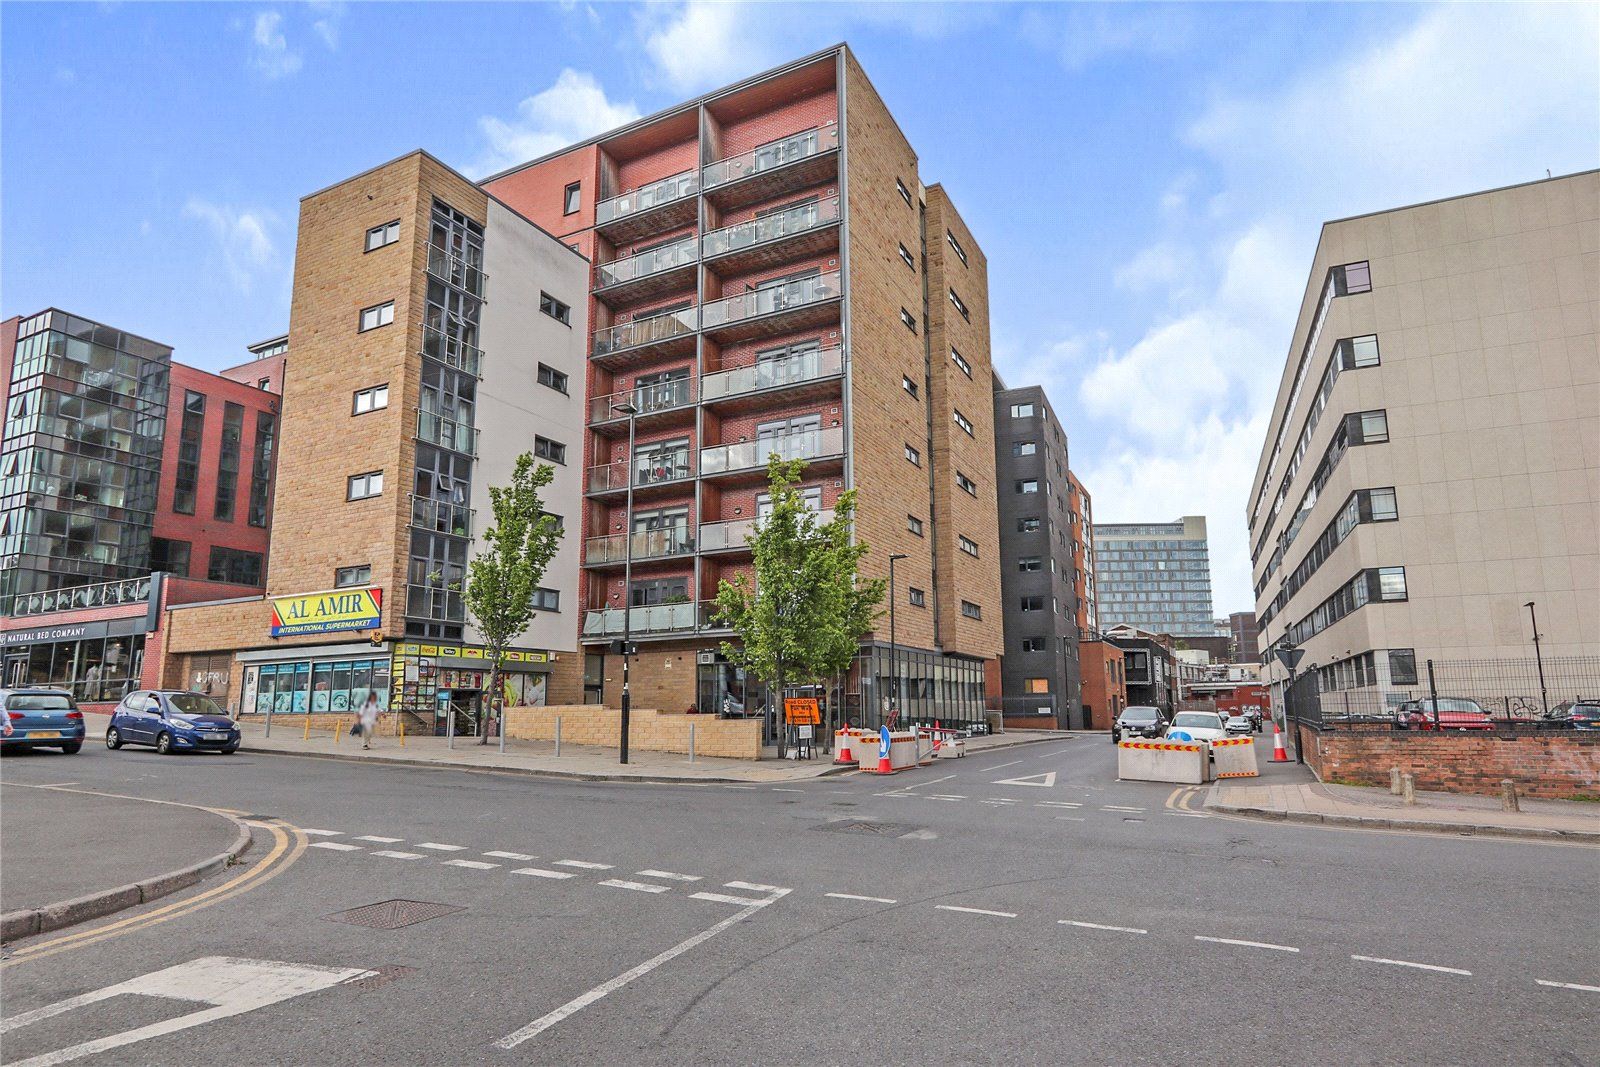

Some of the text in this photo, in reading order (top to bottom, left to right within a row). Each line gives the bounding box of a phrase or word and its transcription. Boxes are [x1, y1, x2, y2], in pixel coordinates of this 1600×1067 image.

[287, 593, 364, 620] AL AMIR
[278, 619, 372, 634] INTERNATIONAL SUPERMARKET
[7, 627, 86, 643] NATURAL BED COMPANY
